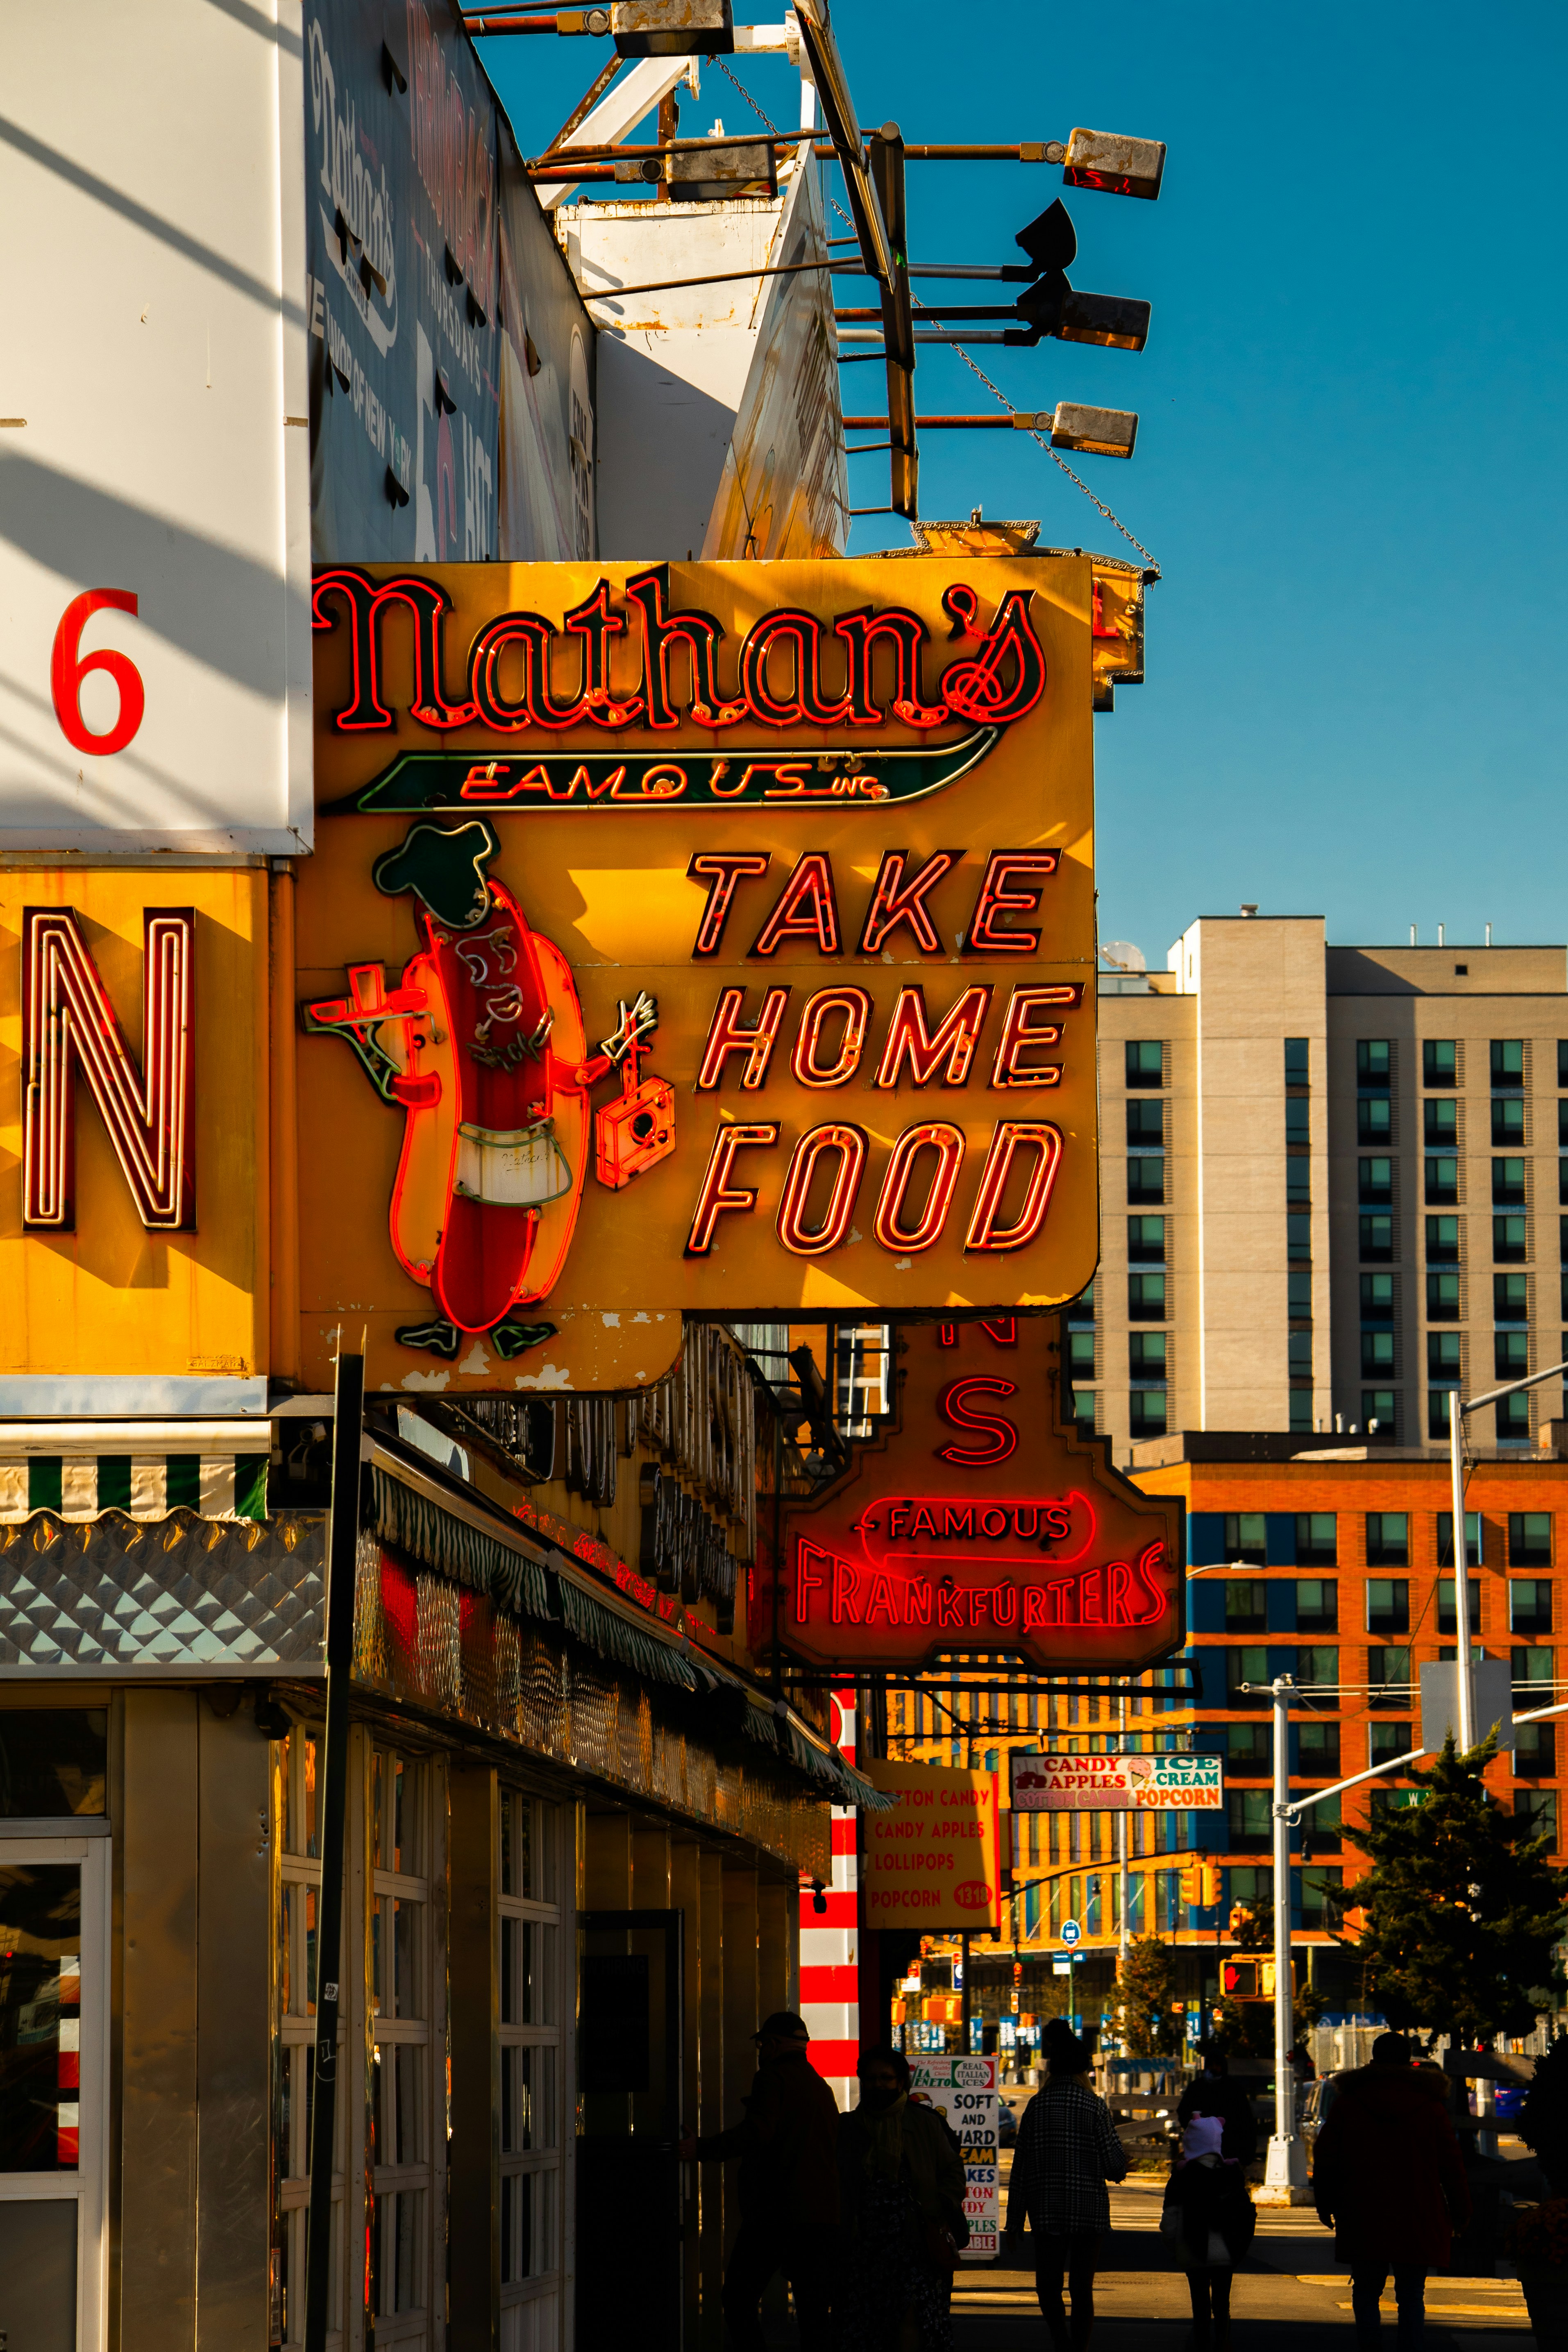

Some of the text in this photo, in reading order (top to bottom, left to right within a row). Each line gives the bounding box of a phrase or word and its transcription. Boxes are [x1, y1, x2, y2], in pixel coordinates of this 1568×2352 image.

[426, 240, 480, 396] THURSDAYS
[353, 358, 364, 420] OF
[365, 380, 386, 458] NEW
[463, 411, 492, 562] HOT
[312, 561, 1048, 733] Nathan's
[50, 587, 144, 756] 6
[686, 848, 1063, 957] TAKE
[695, 983, 1085, 1091] HOME
[21, 906, 198, 1233] N
[683, 1120, 1065, 1257] FOOD
[888, 1506, 1071, 1540] FAMOUS
[796, 1535, 1167, 1627] FRANKFURTERS
[1044, 1758, 1121, 1772] CANDY
[1153, 1756, 1219, 1770] ICE
[1048, 1774, 1126, 1789] APPLES
[1156, 1772, 1219, 1785] CREAM
[940, 1789, 989, 1807] CANDY
[1015, 1790, 1131, 1808] COTTON CANDY
[1135, 1788, 1219, 1806] POPCORN
[875, 1821, 984, 1839] CANDY APPLES
[875, 1853, 954, 1871] LOLLIPOPS
[871, 1886, 989, 1909] POPCORN 1318
[953, 2094, 995, 2110] SOFT
[961, 2114, 986, 2125] AND
[960, 2148, 994, 2164] EAM
[967, 2168, 995, 2183] KES
[966, 2186, 994, 2199] TON
[969, 2219, 997, 2233] PLES
